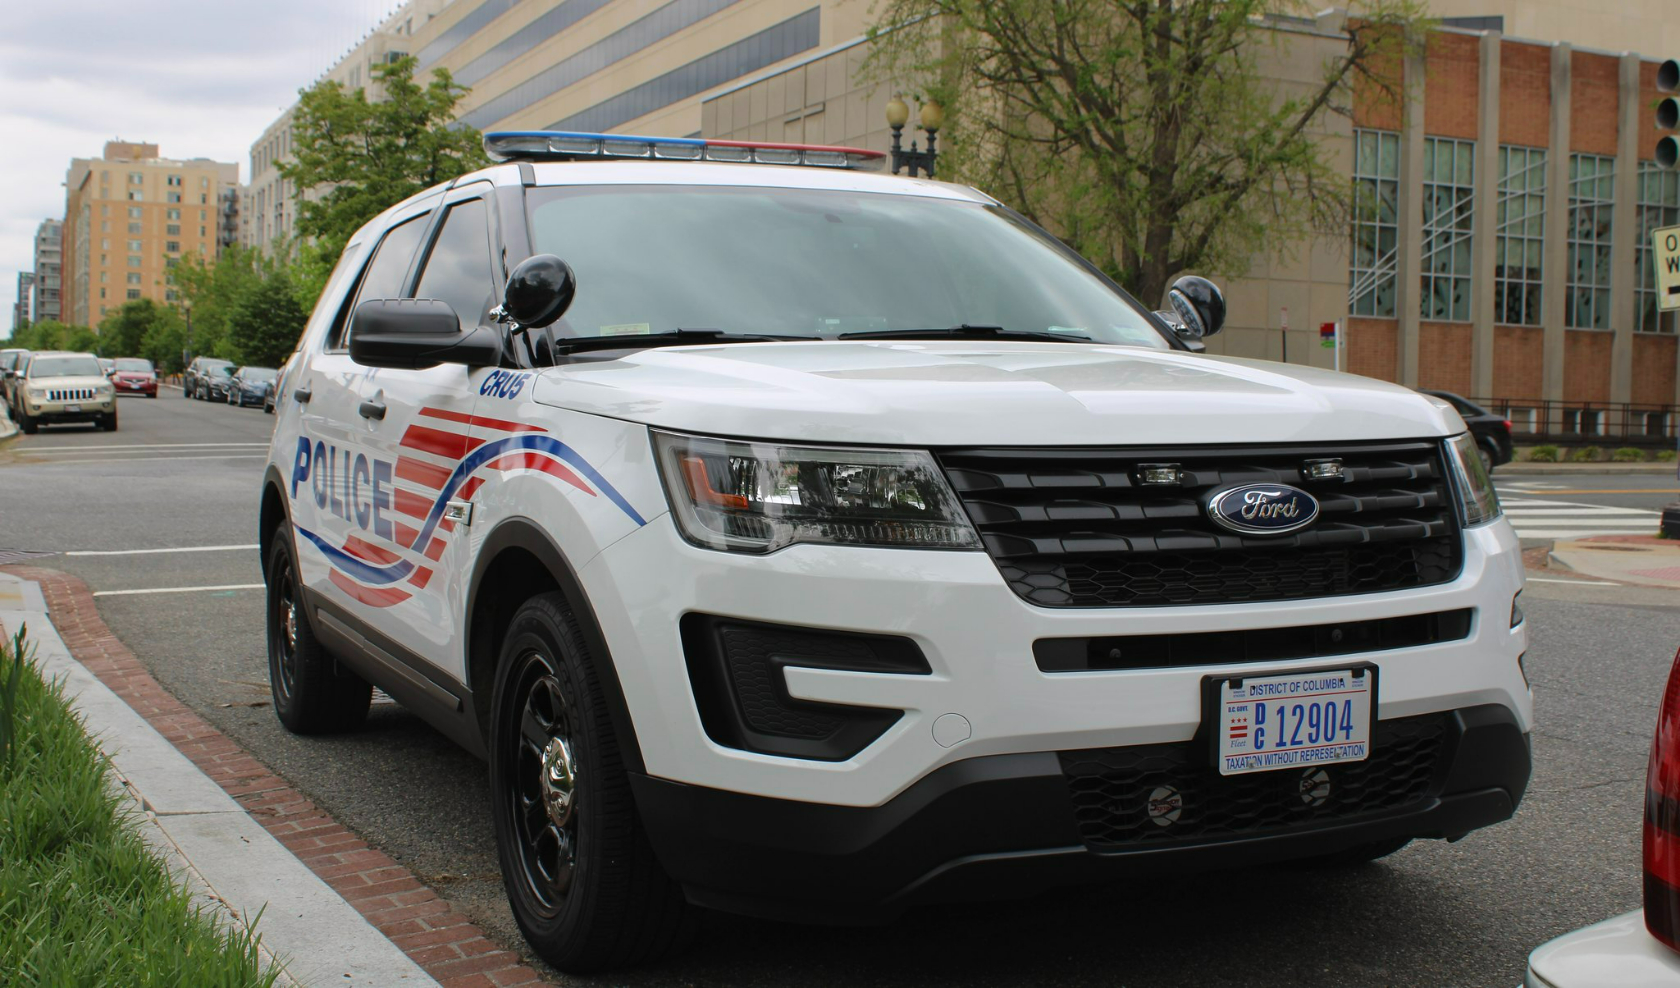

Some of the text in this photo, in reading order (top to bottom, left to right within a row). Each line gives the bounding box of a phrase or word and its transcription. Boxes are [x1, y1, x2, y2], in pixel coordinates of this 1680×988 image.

[1666, 233, 1680, 252] O
[291, 436, 393, 542] POLICE
[1241, 490, 1300, 520] Ford
[1249, 682, 1288, 697] DISTRICT
[1289, 681, 1301, 693] OF
[1302, 677, 1346, 692] COLUMBIA
[1275, 699, 1354, 748] 12904
[1264, 751, 1299, 766] WITHOUT
